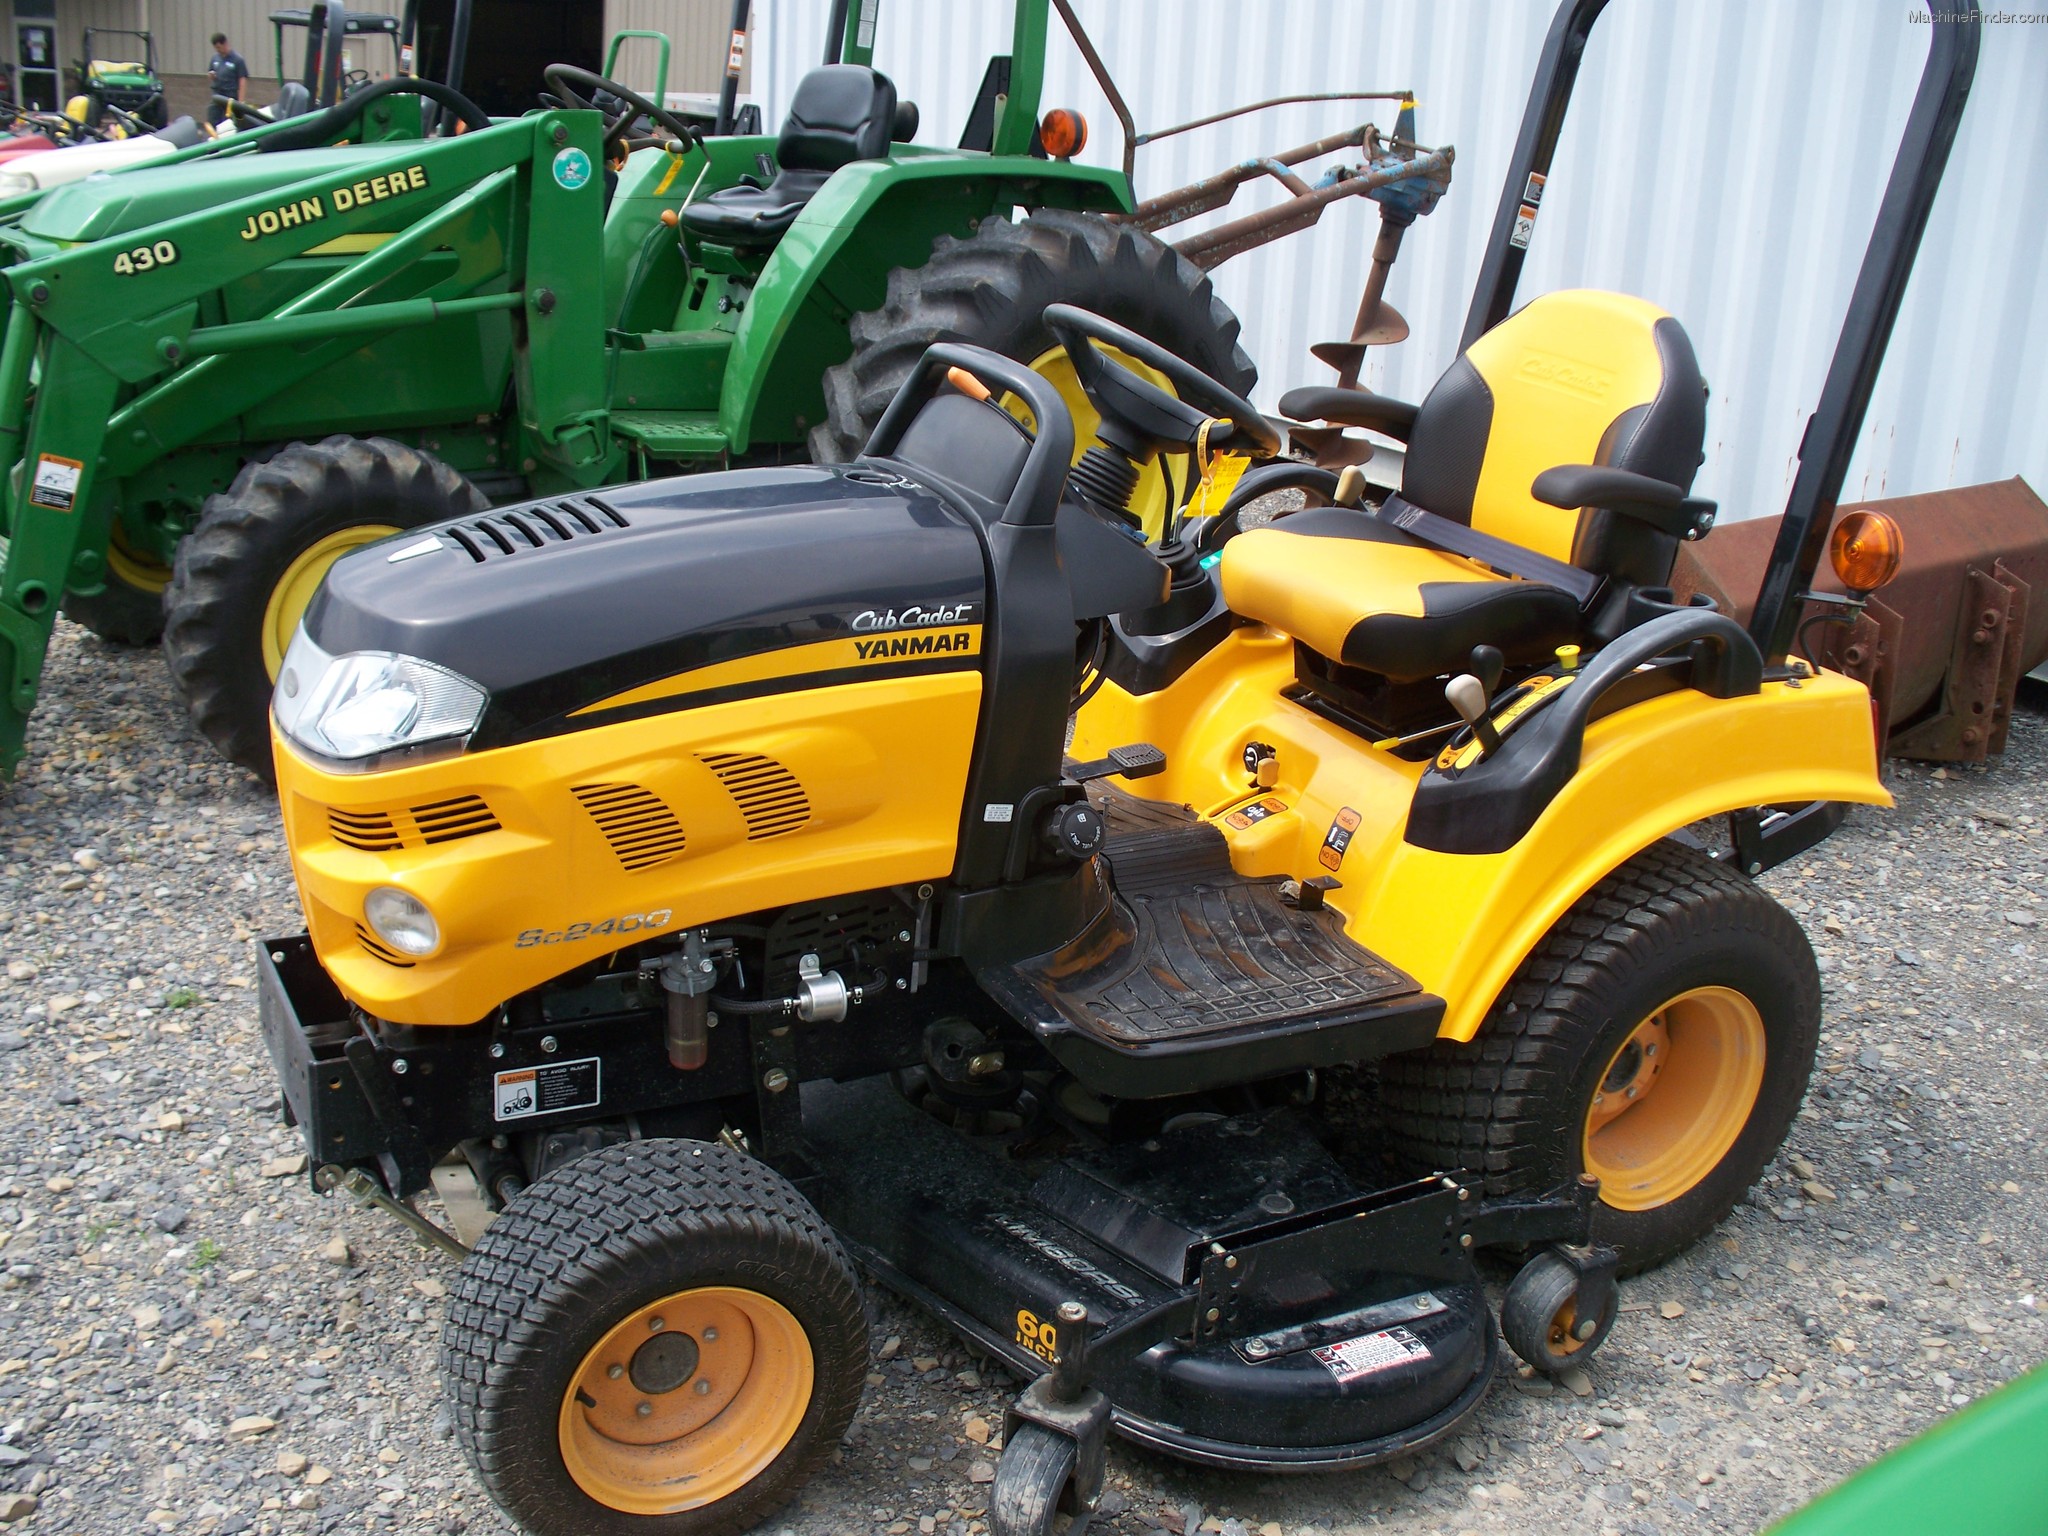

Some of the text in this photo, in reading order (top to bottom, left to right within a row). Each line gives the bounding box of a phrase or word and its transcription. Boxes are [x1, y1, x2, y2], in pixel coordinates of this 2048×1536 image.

[240, 164, 428, 242] JOHN DEERE
[113, 240, 178, 277] 430
[851, 603, 973, 632] Cub Cadet
[854, 632, 970, 660] YANMAR
[1016, 1309, 1057, 1351] 60
